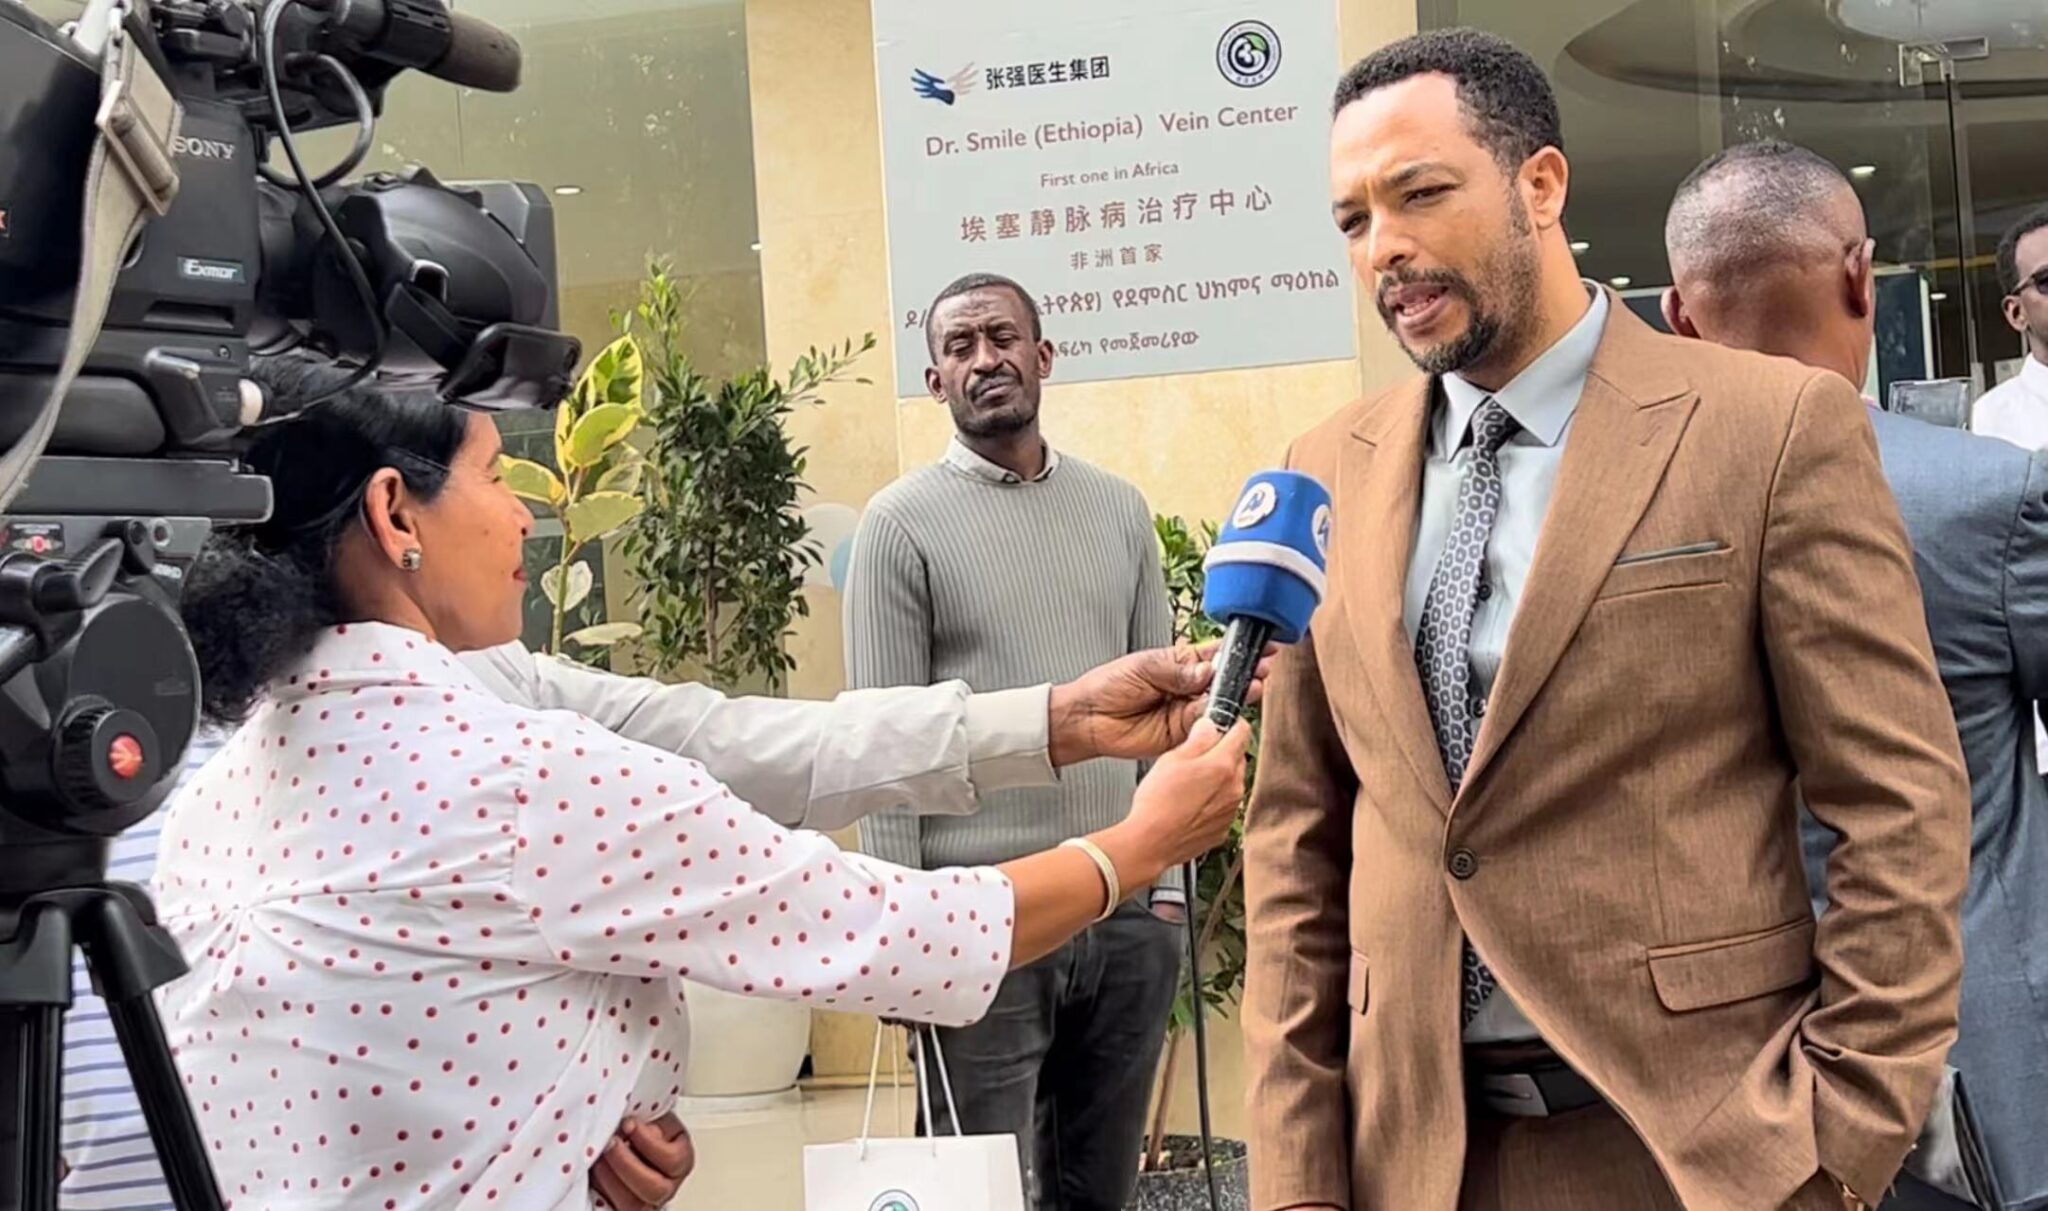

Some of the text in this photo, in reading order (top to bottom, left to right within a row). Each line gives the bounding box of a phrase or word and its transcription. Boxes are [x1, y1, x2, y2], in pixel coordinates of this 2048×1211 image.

[985, 55, 1110, 90] 张强医生集团
[926, 105, 1299, 157] Dr. Smile (Ethiopia) Vein Center
[172, 135, 236, 160] SONY
[1040, 161, 1180, 188] First one in Africa
[960, 184, 1273, 243] 埃塞静脉病治疗中心
[183, 258, 238, 281] Exmor
[1070, 243, 1164, 271] 非洲首家
